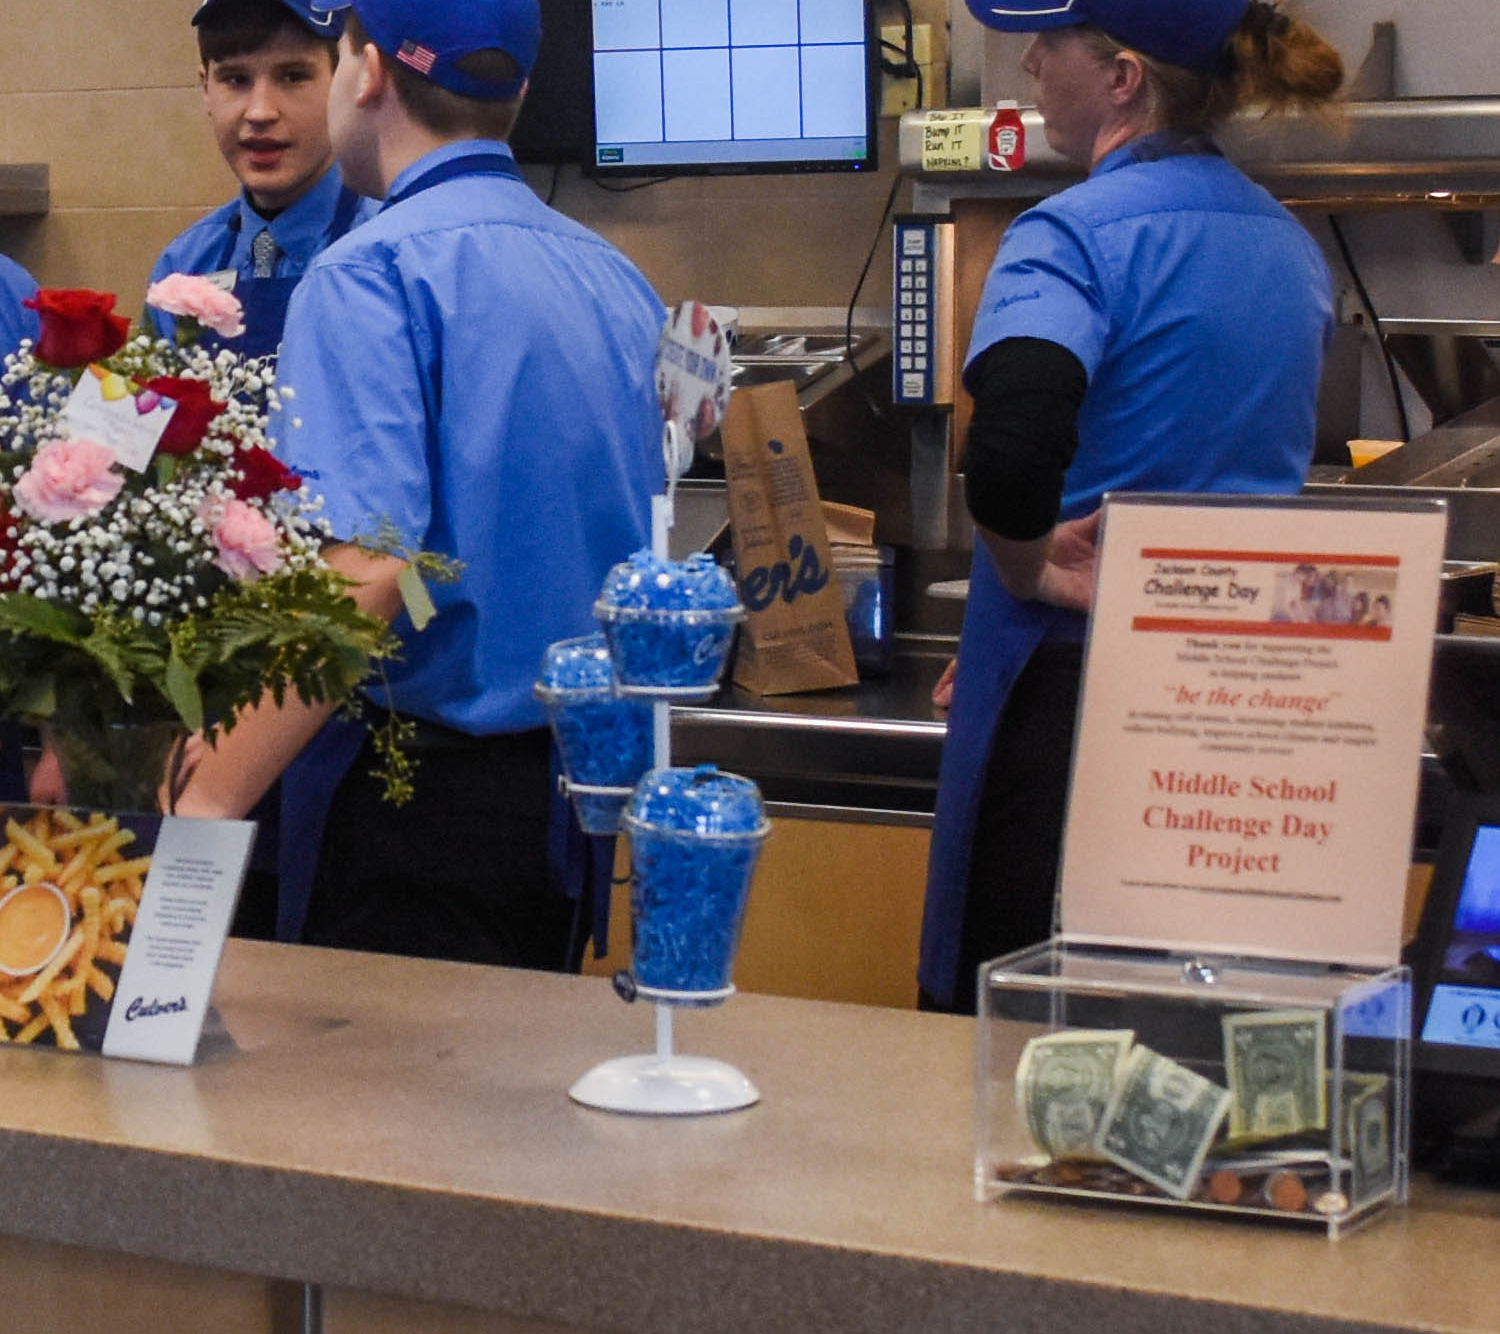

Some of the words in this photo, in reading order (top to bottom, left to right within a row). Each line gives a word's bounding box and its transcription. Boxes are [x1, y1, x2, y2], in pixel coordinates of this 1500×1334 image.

[926, 141, 943, 151] Run
[1144, 580, 1220, 600] Challenge
[1228, 583, 1259, 603] Day
[1207, 686, 1241, 708] the
[1150, 771, 1240, 798] Middle
[1248, 777, 1337, 803] School
[1144, 806, 1271, 837] Challenge
[1281, 813, 1332, 844] Day
[1187, 844, 1280, 874] Project
[126, 995, 188, 1021] Culver's
